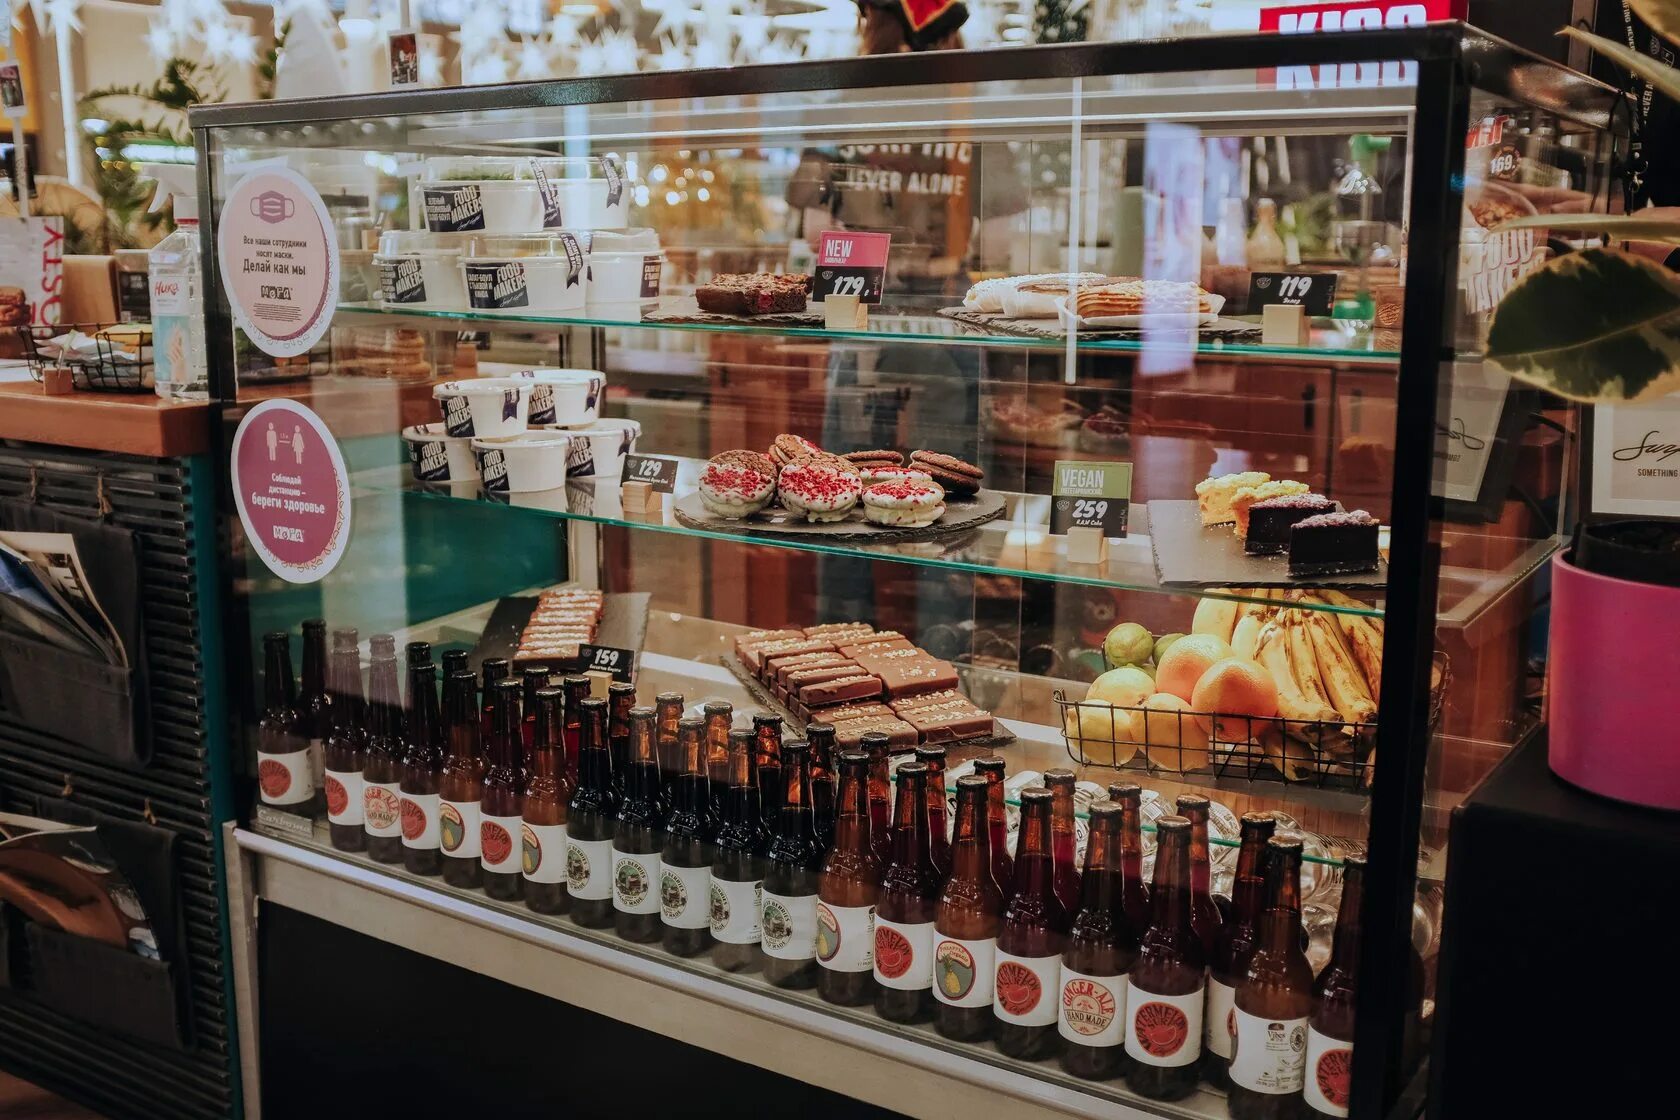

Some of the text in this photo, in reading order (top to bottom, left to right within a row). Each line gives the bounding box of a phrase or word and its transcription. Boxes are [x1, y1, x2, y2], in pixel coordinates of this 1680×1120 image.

[907, 172, 966, 196] ALONE
[454, 185, 477, 208] FOOD
[243, 236, 307, 248] Все наши сотрудники
[825, 239, 854, 258] NEW
[256, 251, 272, 259] носят
[243, 258, 306, 276] Делай как мы
[397, 259, 419, 279] FOOD
[496, 262, 521, 284] FOOD
[493, 273, 527, 301] MAKERS
[832, 276, 865, 296] 179
[1279, 276, 1312, 297] 119
[446, 395, 465, 413] FOOD
[421, 441, 441, 457] FOOD
[484, 450, 502, 467] FOOD
[638, 460, 662, 477] 129
[1061, 468, 1105, 488] VEGAN
[1637, 468, 1679, 478] SOMETHING
[271, 472, 302, 485] Соблюдай
[252, 492, 325, 515] береги здоровье
[1072, 499, 1108, 519] 259
[594, 649, 619, 666] 159
[1063, 982, 1114, 1014] GINGER-ALE
[1067, 1011, 1107, 1027] HAND MADE
